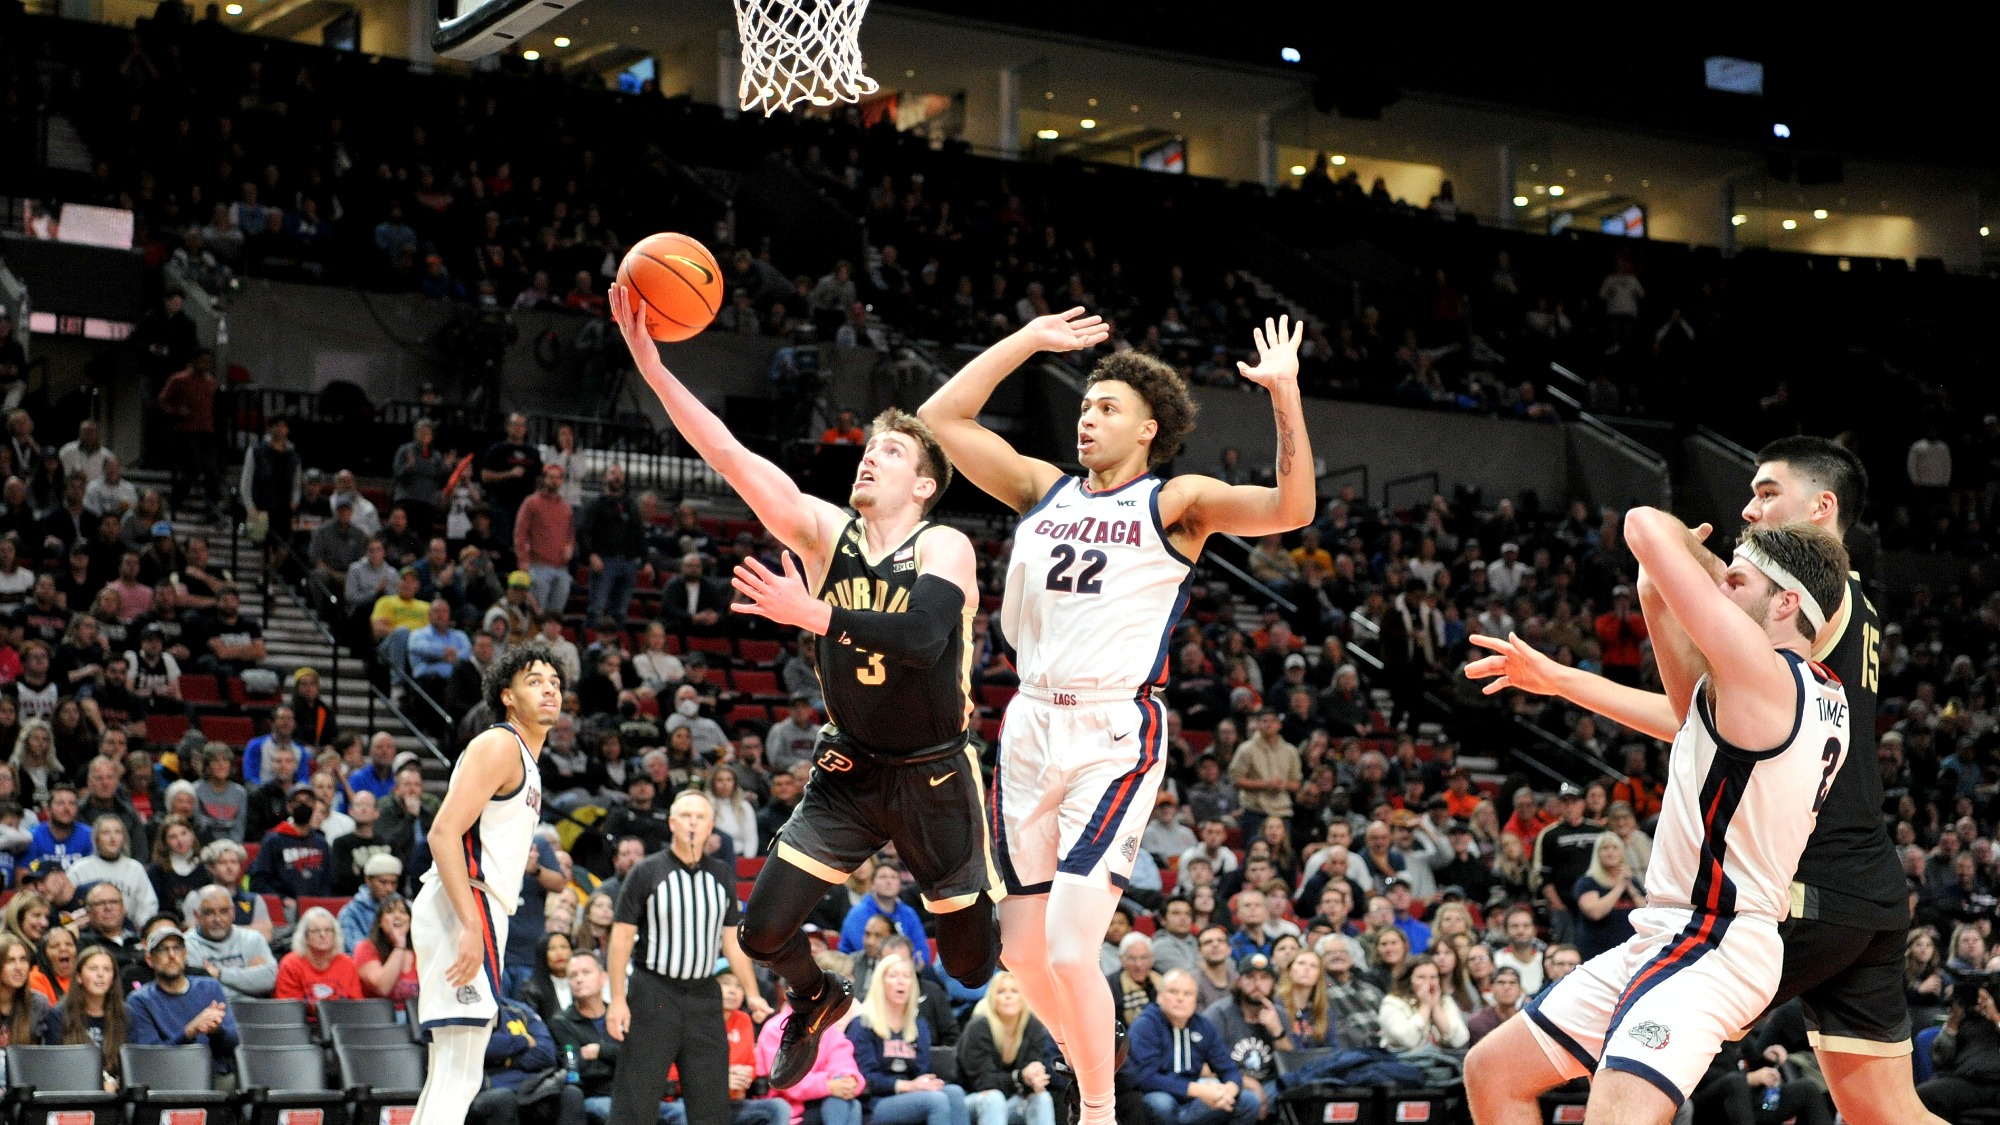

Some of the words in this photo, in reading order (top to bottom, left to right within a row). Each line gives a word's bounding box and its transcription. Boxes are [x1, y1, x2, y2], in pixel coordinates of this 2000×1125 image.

[1035, 517, 1141, 547] GONZAGA
[1046, 544, 1107, 594] 22
[824, 577, 911, 614] PURDU
[856, 647, 886, 685] 3
[1861, 621, 1880, 694] 15
[1053, 693, 1077, 706] ZAGS
[817, 749, 853, 772] P
[1812, 736, 1842, 813] 2
